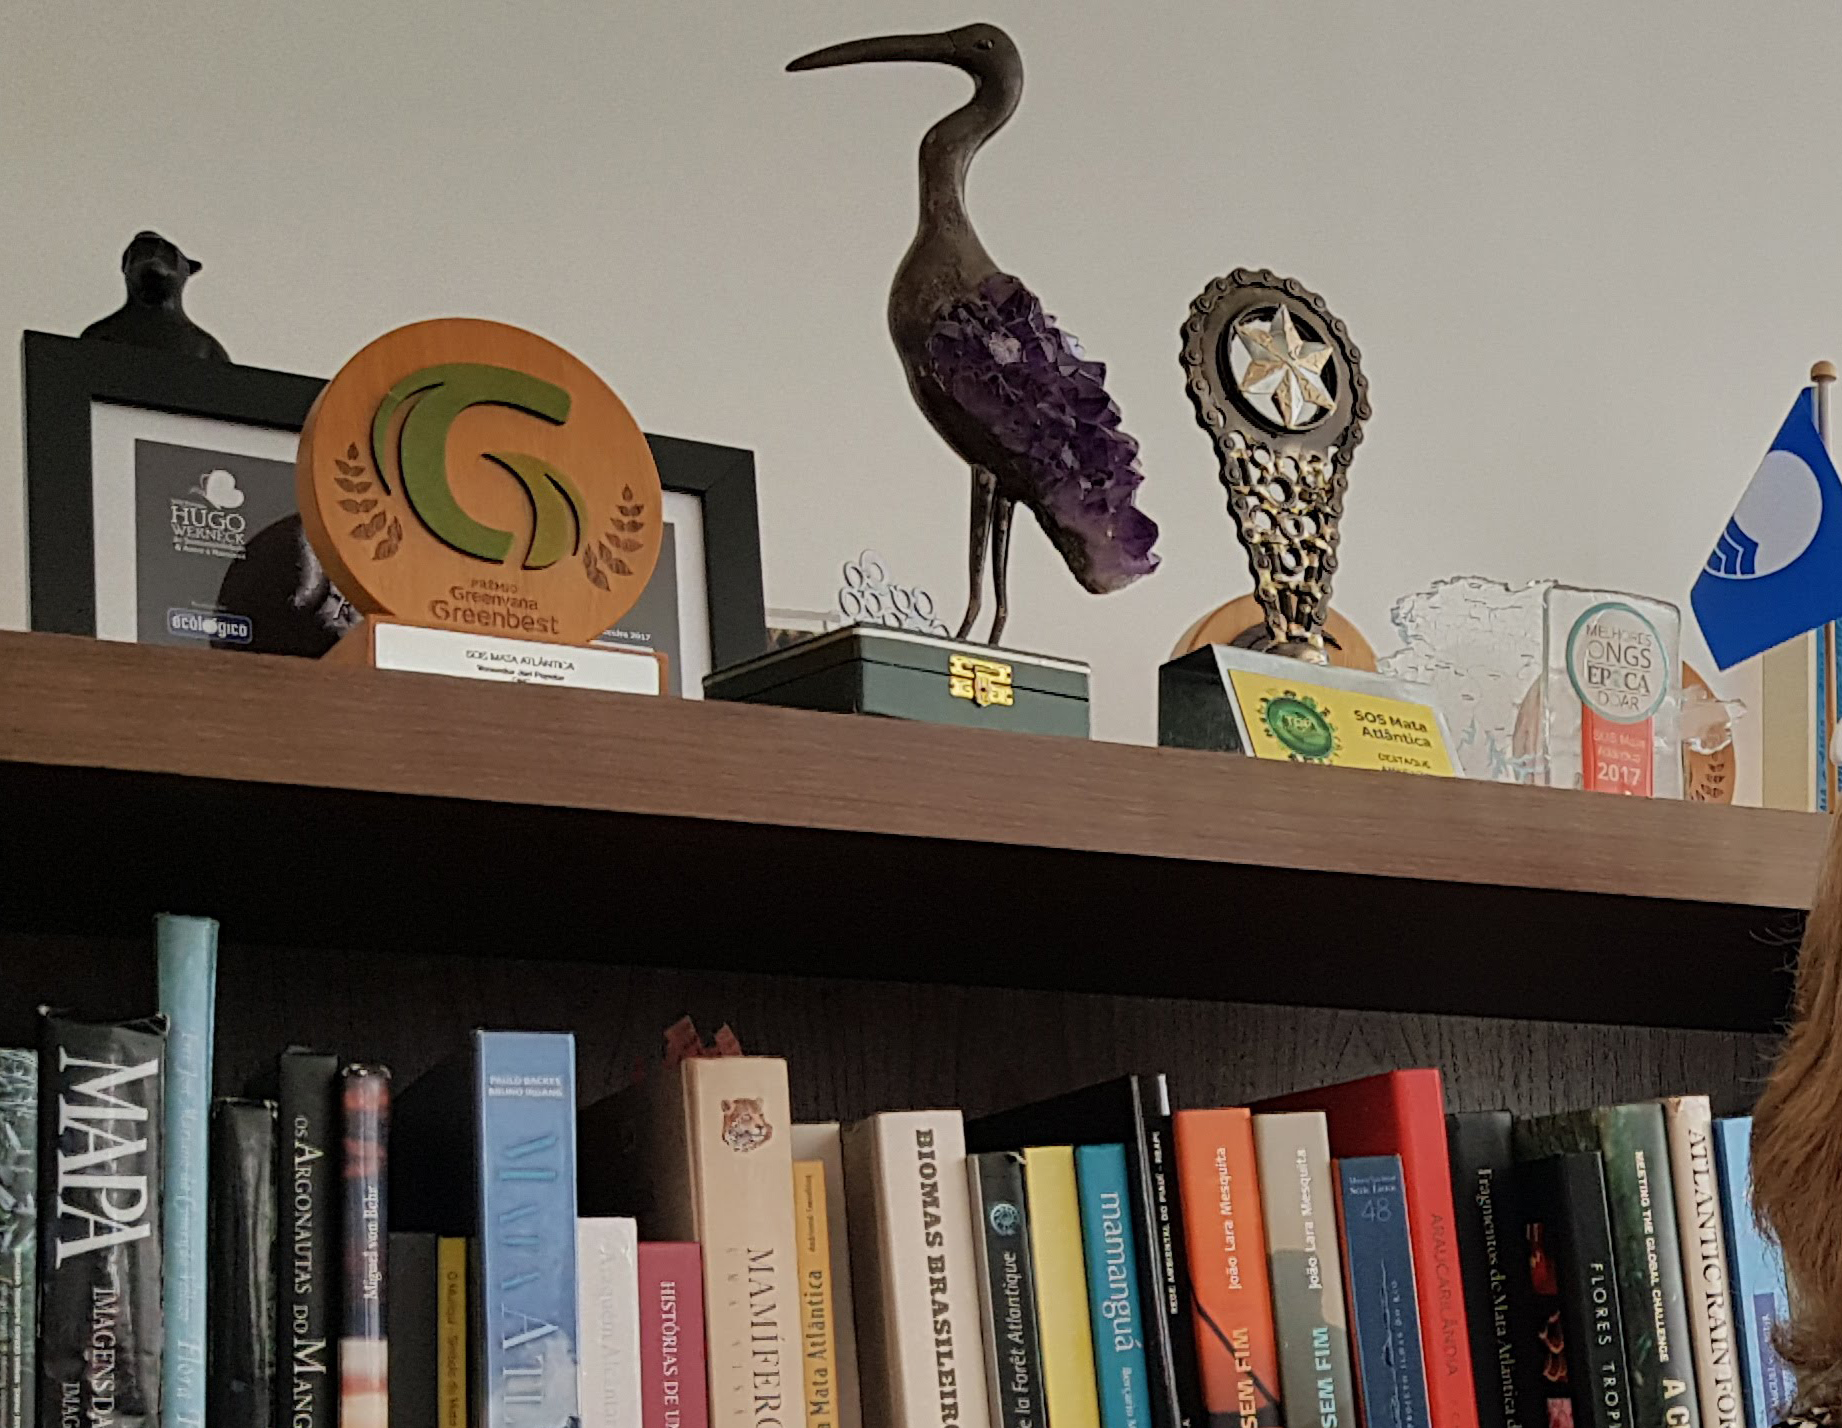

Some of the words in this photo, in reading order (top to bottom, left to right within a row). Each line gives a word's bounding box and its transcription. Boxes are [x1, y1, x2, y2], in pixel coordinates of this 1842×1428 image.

[171, 505, 246, 533] HUGO
[429, 599, 560, 635] Greenbest
[449, 585, 539, 611] Greenvana
[1587, 639, 1652, 669] ONGS
[1353, 709, 1387, 726] SOS
[1389, 715, 1428, 733] Mata
[1362, 726, 1433, 749] Atlântica
[1597, 762, 1642, 786] 2017
[55, 1045, 159, 1271] MAPA
[1634, 1151, 1652, 1208] MEETING
[914, 1129, 944, 1248] BIOMAS
[1214, 1146, 1233, 1217] Mesquita
[1295, 1147, 1315, 1217] Mesquita
[293, 1137, 326, 1295] ARGONAUTAS
[1361, 1197, 1392, 1222] 48
[1641, 1210, 1656, 1235] THE
[1687, 1128, 1724, 1283] ATLANTIC
[363, 1221, 380, 1249] von
[1223, 1219, 1243, 1254] Lara
[1302, 1219, 1317, 1254] Lara
[362, 1250, 381, 1302] Miguel
[1100, 1190, 1143, 1352] mamanguá
[1228, 1256, 1243, 1290] João
[1307, 1256, 1324, 1291] João
[1488, 1268, 1506, 1293] de
[1644, 1236, 1661, 1287] GLOBAL
[291, 1304, 309, 1333] DO
[803, 1268, 828, 1361] Atlântica
[1002, 1250, 1025, 1345] Atlantique
[1589, 1263, 1612, 1347] FLORES
[91, 1285, 117, 1392] IMAGENS
[660, 1281, 680, 1377] HISTÓRIAS
[1651, 1288, 1669, 1363] CHALLENGE
[1703, 1288, 1732, 1368] RAIN
[1011, 1348, 1030, 1392] Forêt
[1231, 1327, 1252, 1373] FIM
[1311, 1326, 1332, 1372] FIM
[663, 1379, 680, 1404] DE
[807, 1365, 830, 1416] Mata
[1013, 1395, 1031, 1413] la
[1662, 1378, 1686, 1399] A
[90, 1396, 116, 1428] DA
